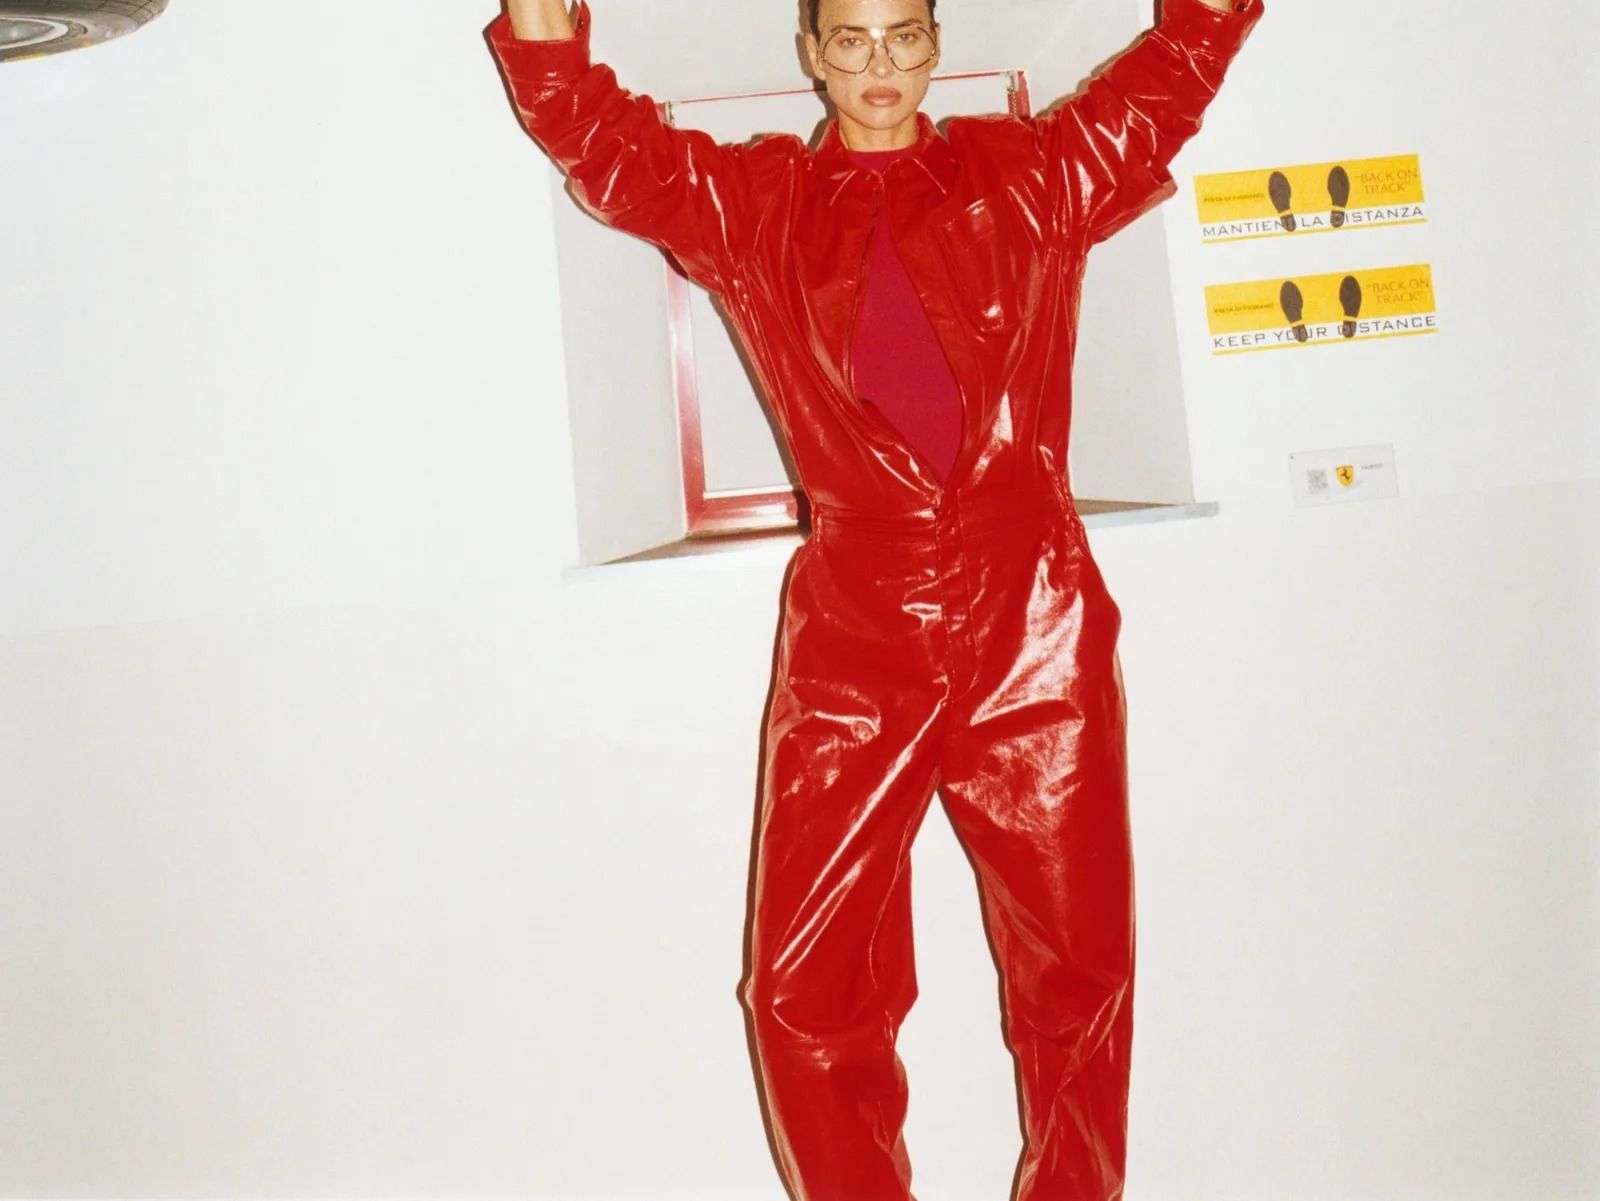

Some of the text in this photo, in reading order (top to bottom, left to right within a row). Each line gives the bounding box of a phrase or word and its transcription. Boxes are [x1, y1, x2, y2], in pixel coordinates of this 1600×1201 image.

[1301, 215, 1324, 227] LA
[1331, 206, 1424, 225] ISTANZA
[1213, 332, 1266, 349] KEEP
